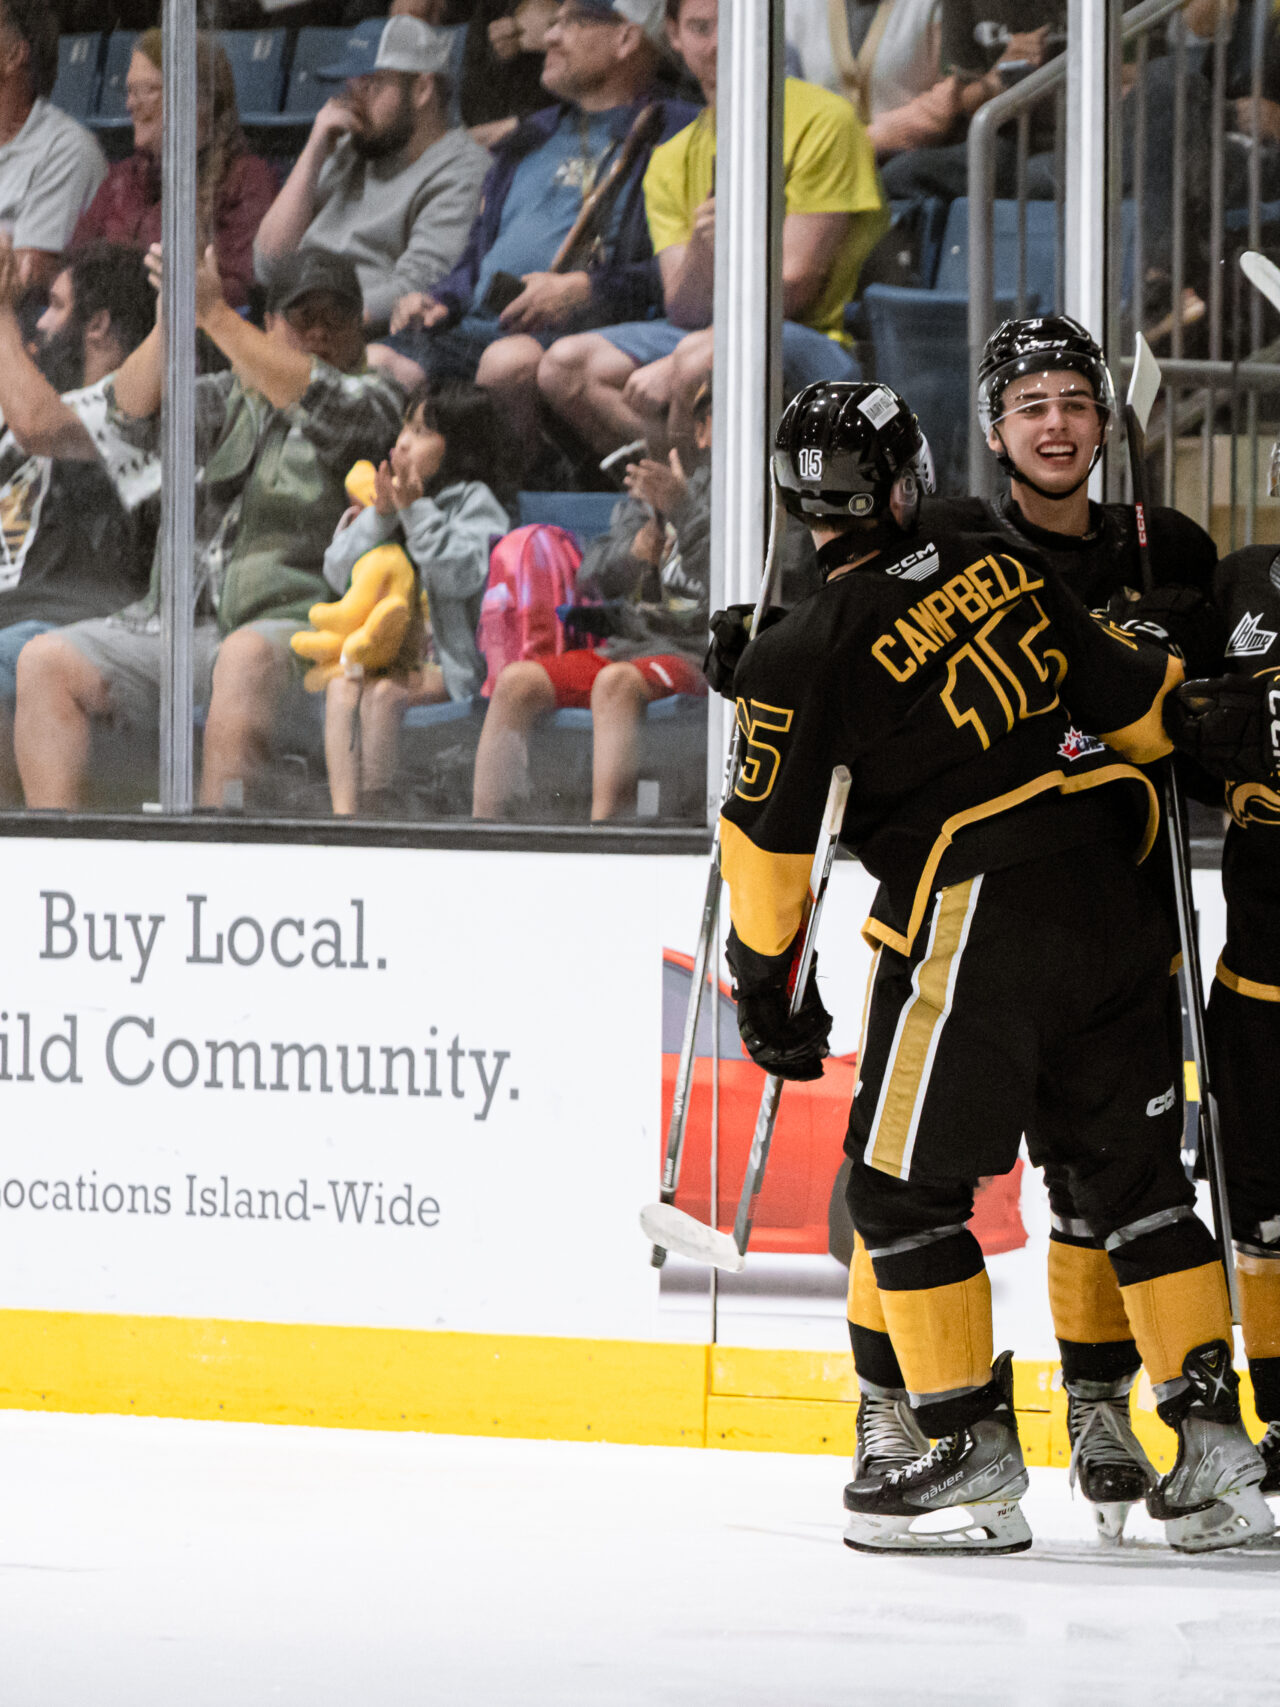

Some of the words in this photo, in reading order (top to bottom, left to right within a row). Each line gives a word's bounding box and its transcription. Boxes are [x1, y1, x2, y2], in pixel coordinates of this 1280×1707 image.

[799, 448, 823, 479] 15
[1136, 503, 1147, 546] CCM
[885, 542, 936, 575] CCM
[871, 553, 1045, 683] CAMPBELL
[939, 593, 1068, 751] 15
[39, 890, 165, 984] Buy
[186, 894, 388, 970] Local.
[105, 1015, 520, 1121] Community.
[0, 1170, 172, 1216] ocations
[186, 1174, 441, 1228] Island-Wide
[920, 1470, 965, 1504] BAUER
